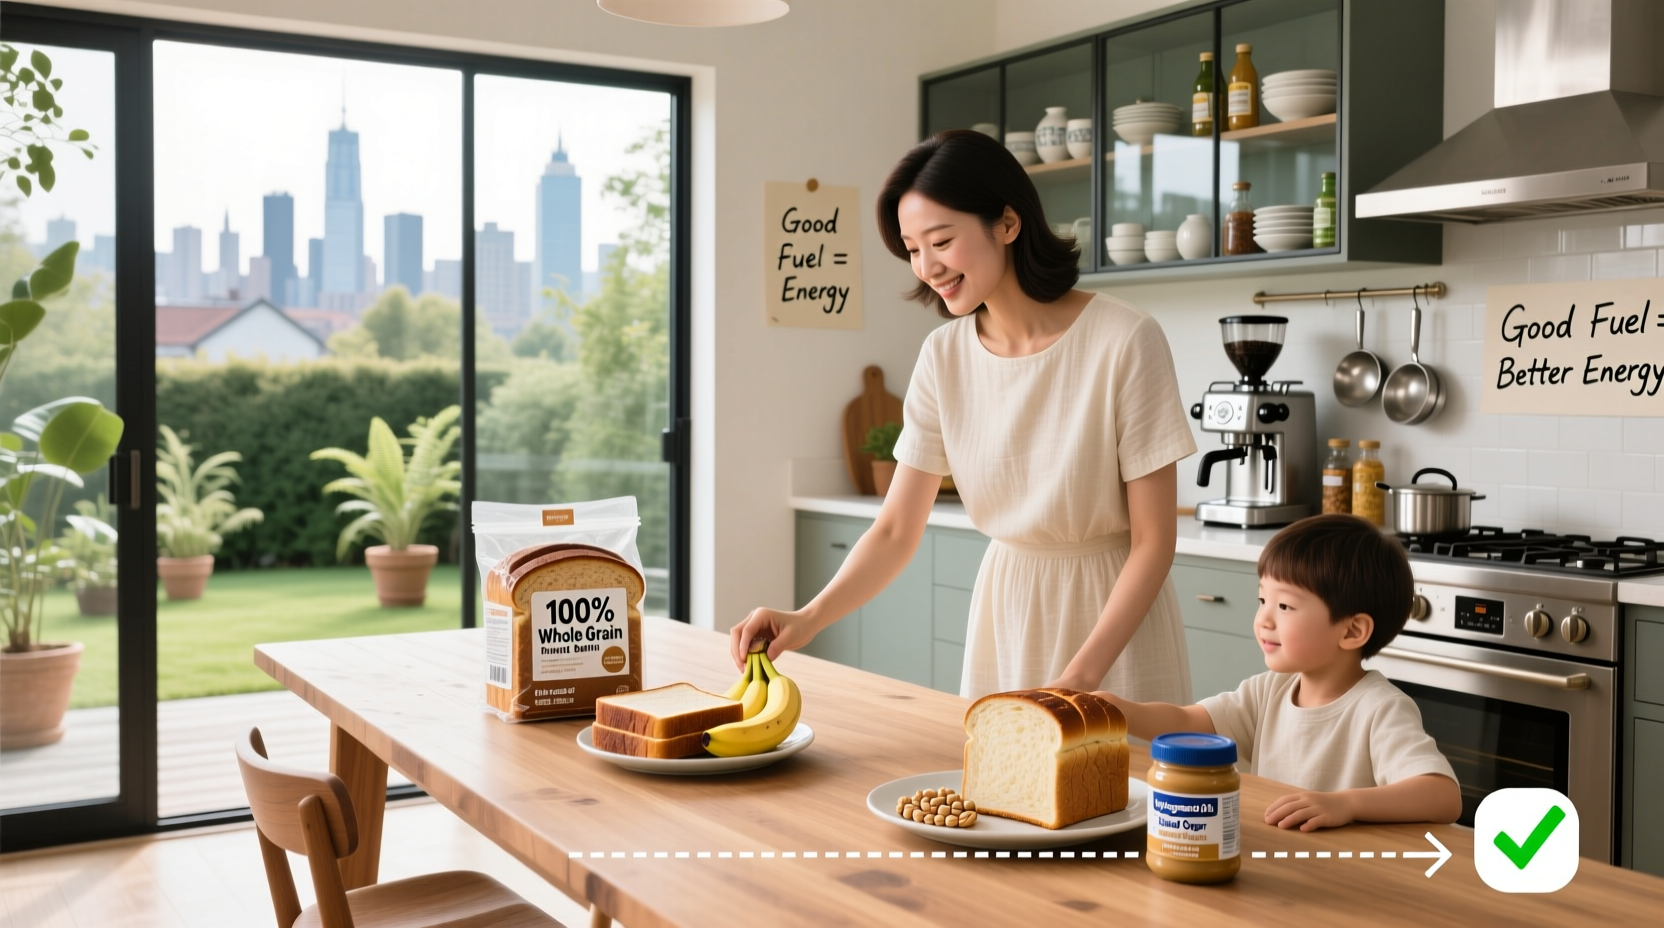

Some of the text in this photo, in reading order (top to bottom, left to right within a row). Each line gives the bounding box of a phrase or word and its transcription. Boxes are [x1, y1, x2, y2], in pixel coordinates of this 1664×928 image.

[782, 207, 839, 233] Good
[778, 243, 824, 270] Fuel
[781, 276, 849, 314] Energy
[1501, 303, 1576, 348] Good
[1591, 299, 1651, 338] Fuel
[1497, 354, 1664, 397] Better Energy
[546, 596, 615, 625] 100%
[538, 625, 622, 644] Whole Grain
